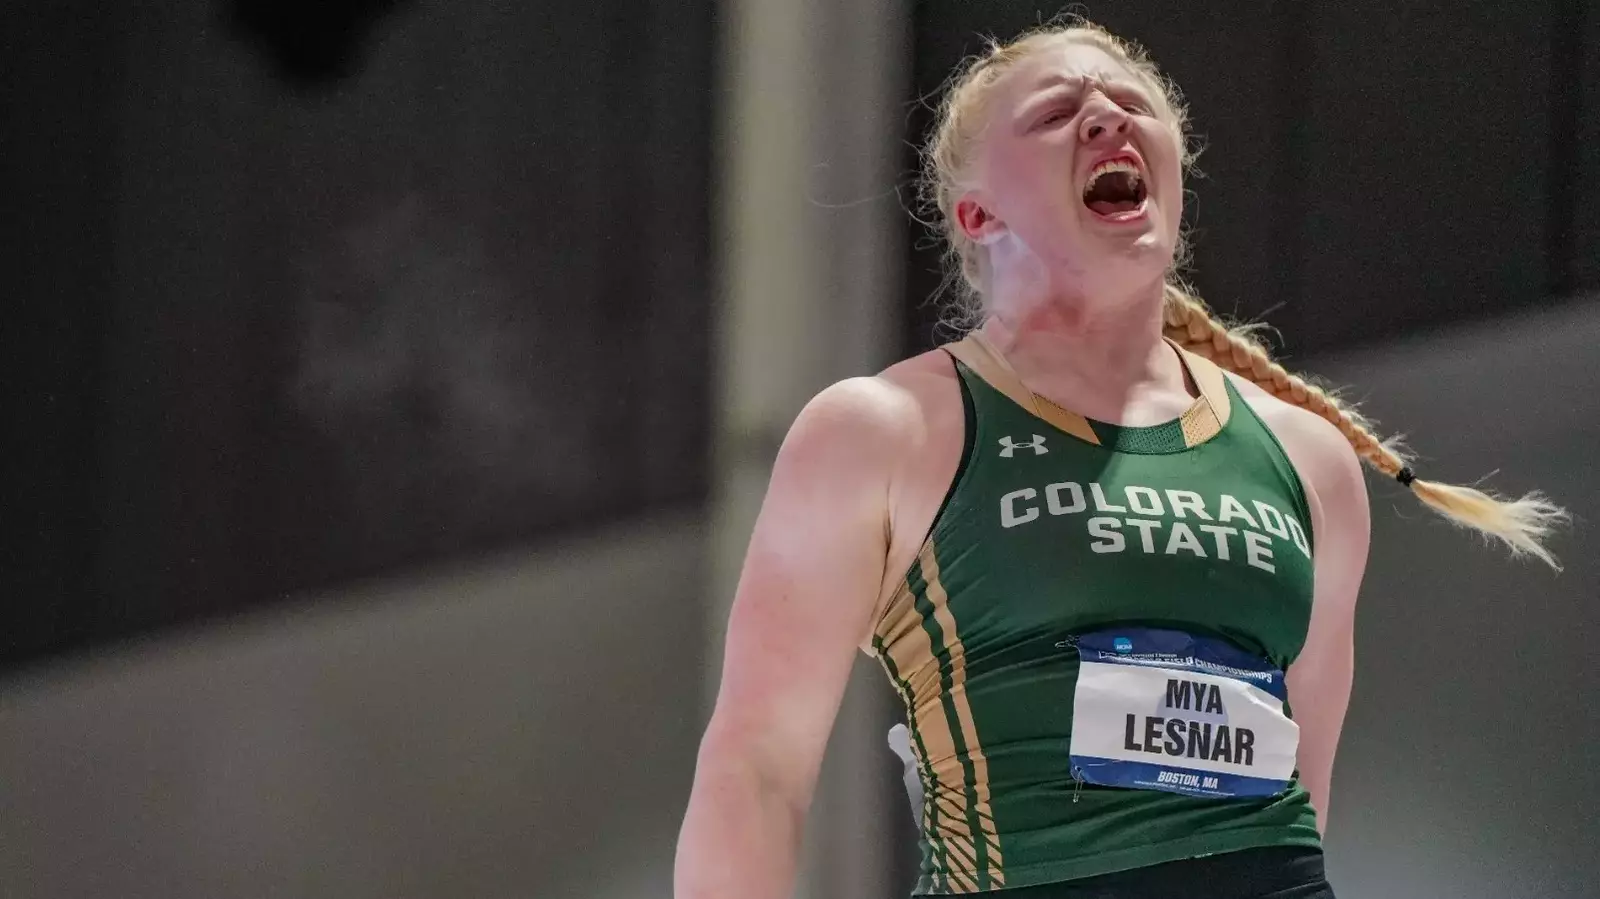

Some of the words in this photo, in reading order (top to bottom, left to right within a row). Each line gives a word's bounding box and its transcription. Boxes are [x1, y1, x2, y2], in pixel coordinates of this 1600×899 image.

[1000, 481, 1311, 558] COLORADO
[1087, 516, 1276, 573] STATE
[1194, 658, 1273, 684] CHAMPIONSHIPS
[1166, 679, 1223, 715] MYA
[1124, 713, 1255, 766] LESNAR
[1157, 770, 1200, 788] BOSTON,
[1202, 775, 1219, 789] MA
